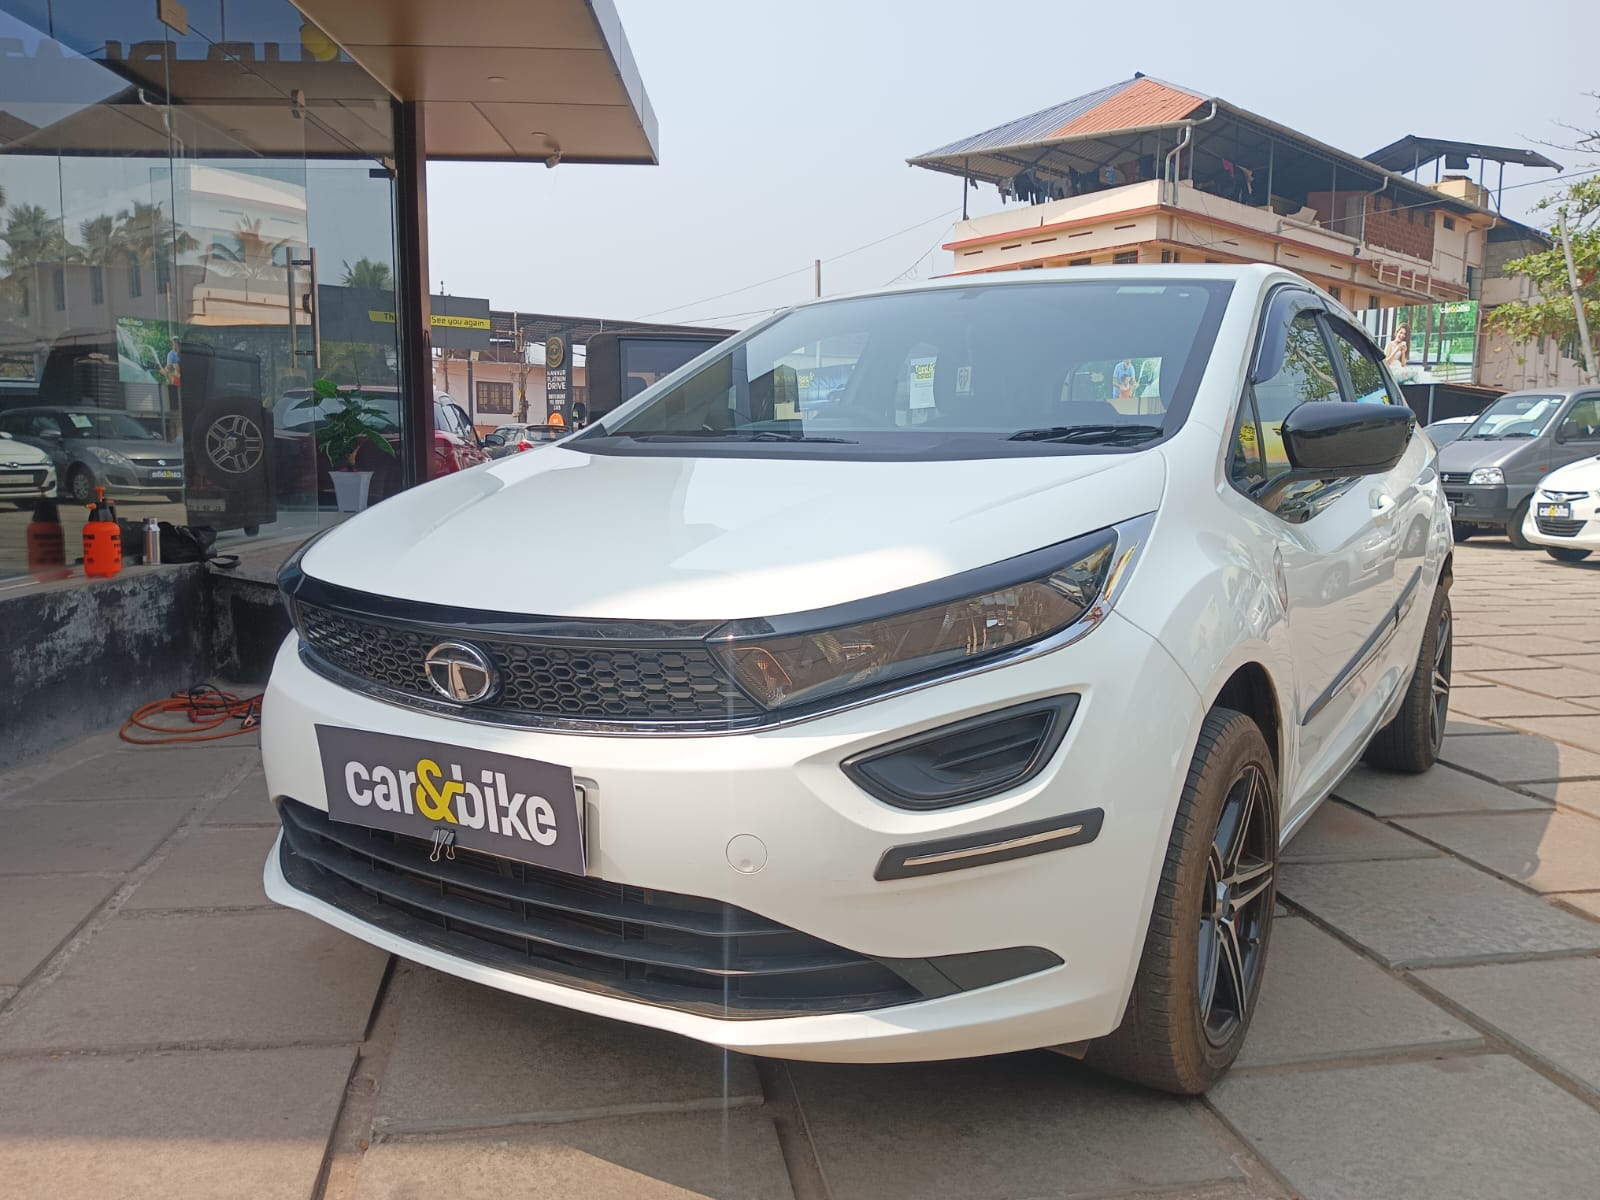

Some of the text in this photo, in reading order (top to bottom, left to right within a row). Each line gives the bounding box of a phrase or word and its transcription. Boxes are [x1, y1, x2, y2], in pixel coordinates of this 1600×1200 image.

[431, 316, 445, 324] See
[463, 319, 485, 328] again
[547, 382, 567, 390] DRIVE
[344, 757, 558, 847] car&bike
